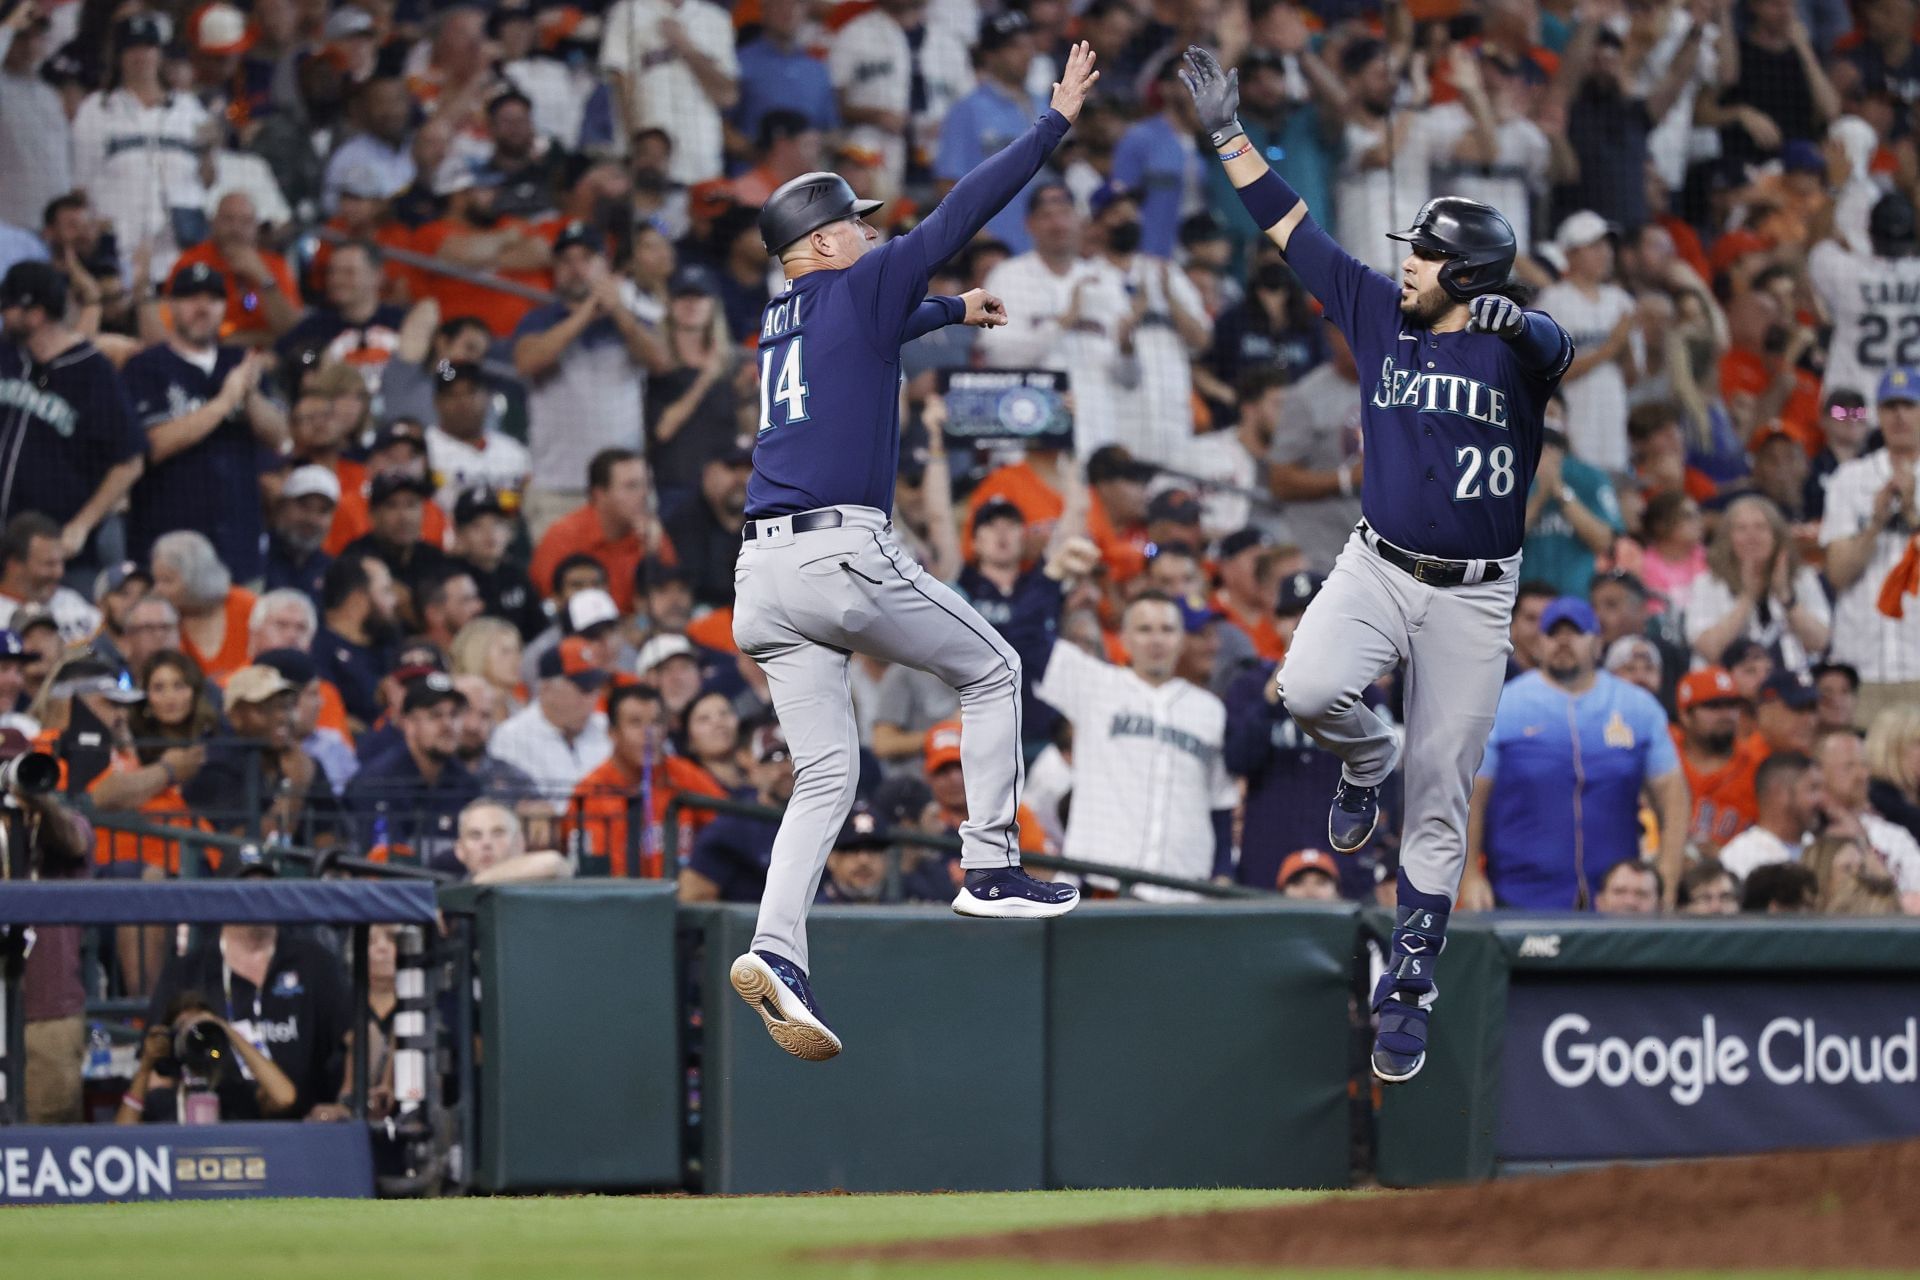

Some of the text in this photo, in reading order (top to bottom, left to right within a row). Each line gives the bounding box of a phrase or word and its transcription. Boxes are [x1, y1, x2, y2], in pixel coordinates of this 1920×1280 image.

[762, 294, 804, 340] ACTA
[1856, 313, 1920, 368] 22
[758, 336, 811, 437] 14
[1370, 354, 1509, 430] SEATTLE
[1454, 443, 1516, 501] 28
[1421, 913, 1433, 929] S
[1412, 959, 1421, 975] S
[1541, 1012, 1918, 1106] Google Cloud
[0, 1145, 267, 1197] EASON 2022
